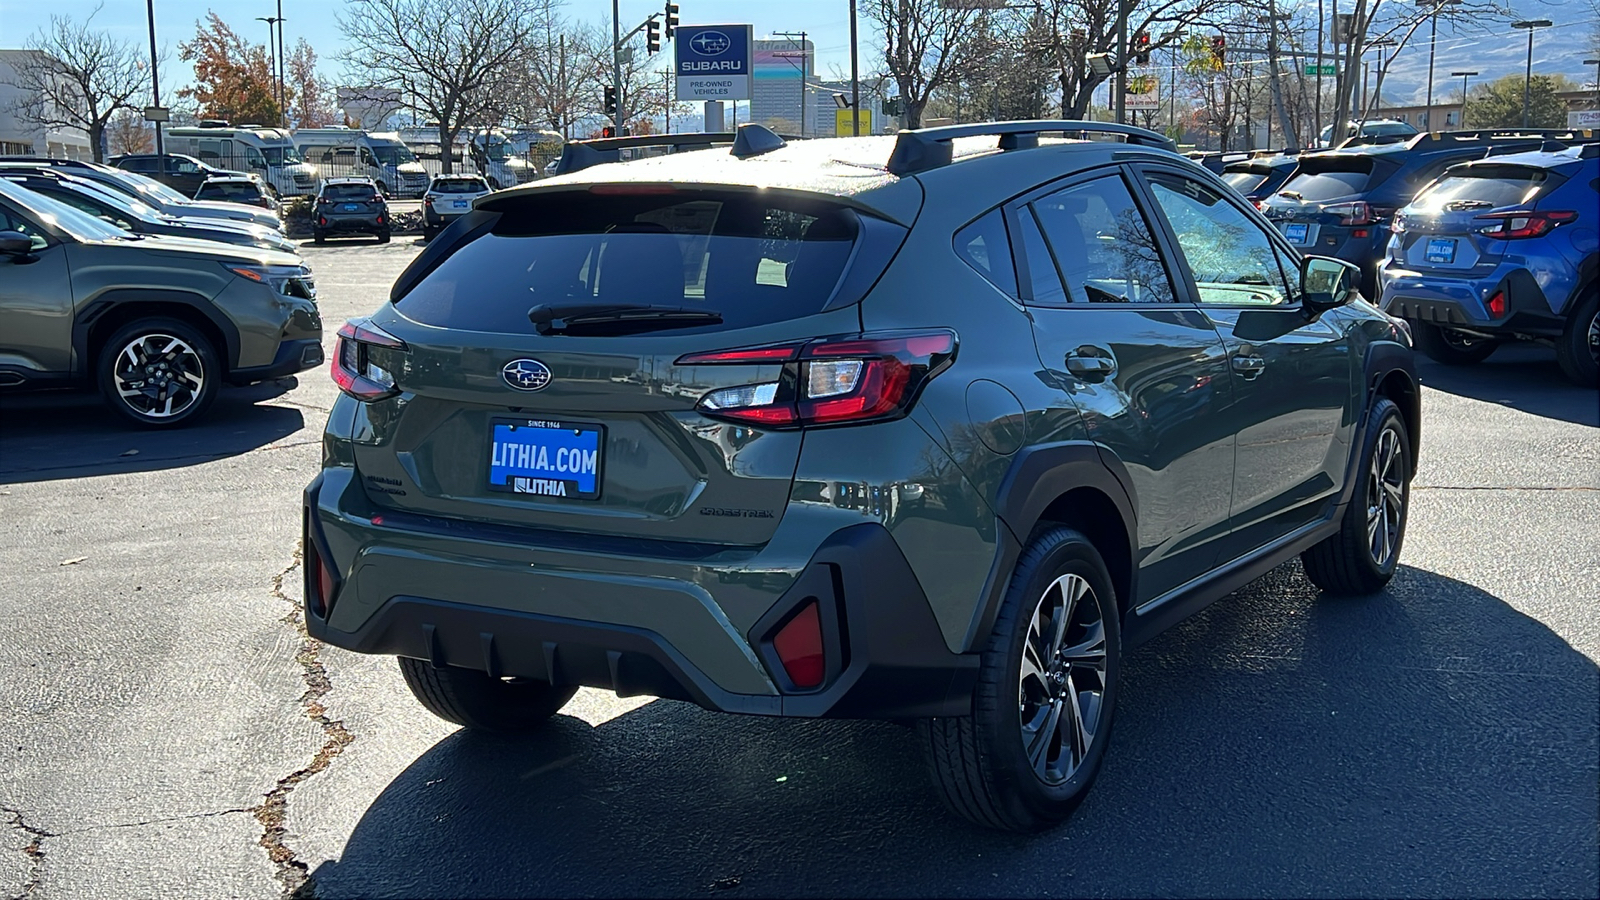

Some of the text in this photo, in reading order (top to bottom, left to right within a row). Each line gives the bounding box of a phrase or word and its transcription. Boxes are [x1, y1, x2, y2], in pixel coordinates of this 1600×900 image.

[682, 61, 741, 71] SUBARU
[690, 80, 733, 88] PRE-OWNED
[527, 420, 560, 429] SINCE 1946
[491, 441, 597, 475] LITHIA.COM
[525, 478, 567, 497] LITHIA
[700, 506, 774, 518] CROSSTREK
